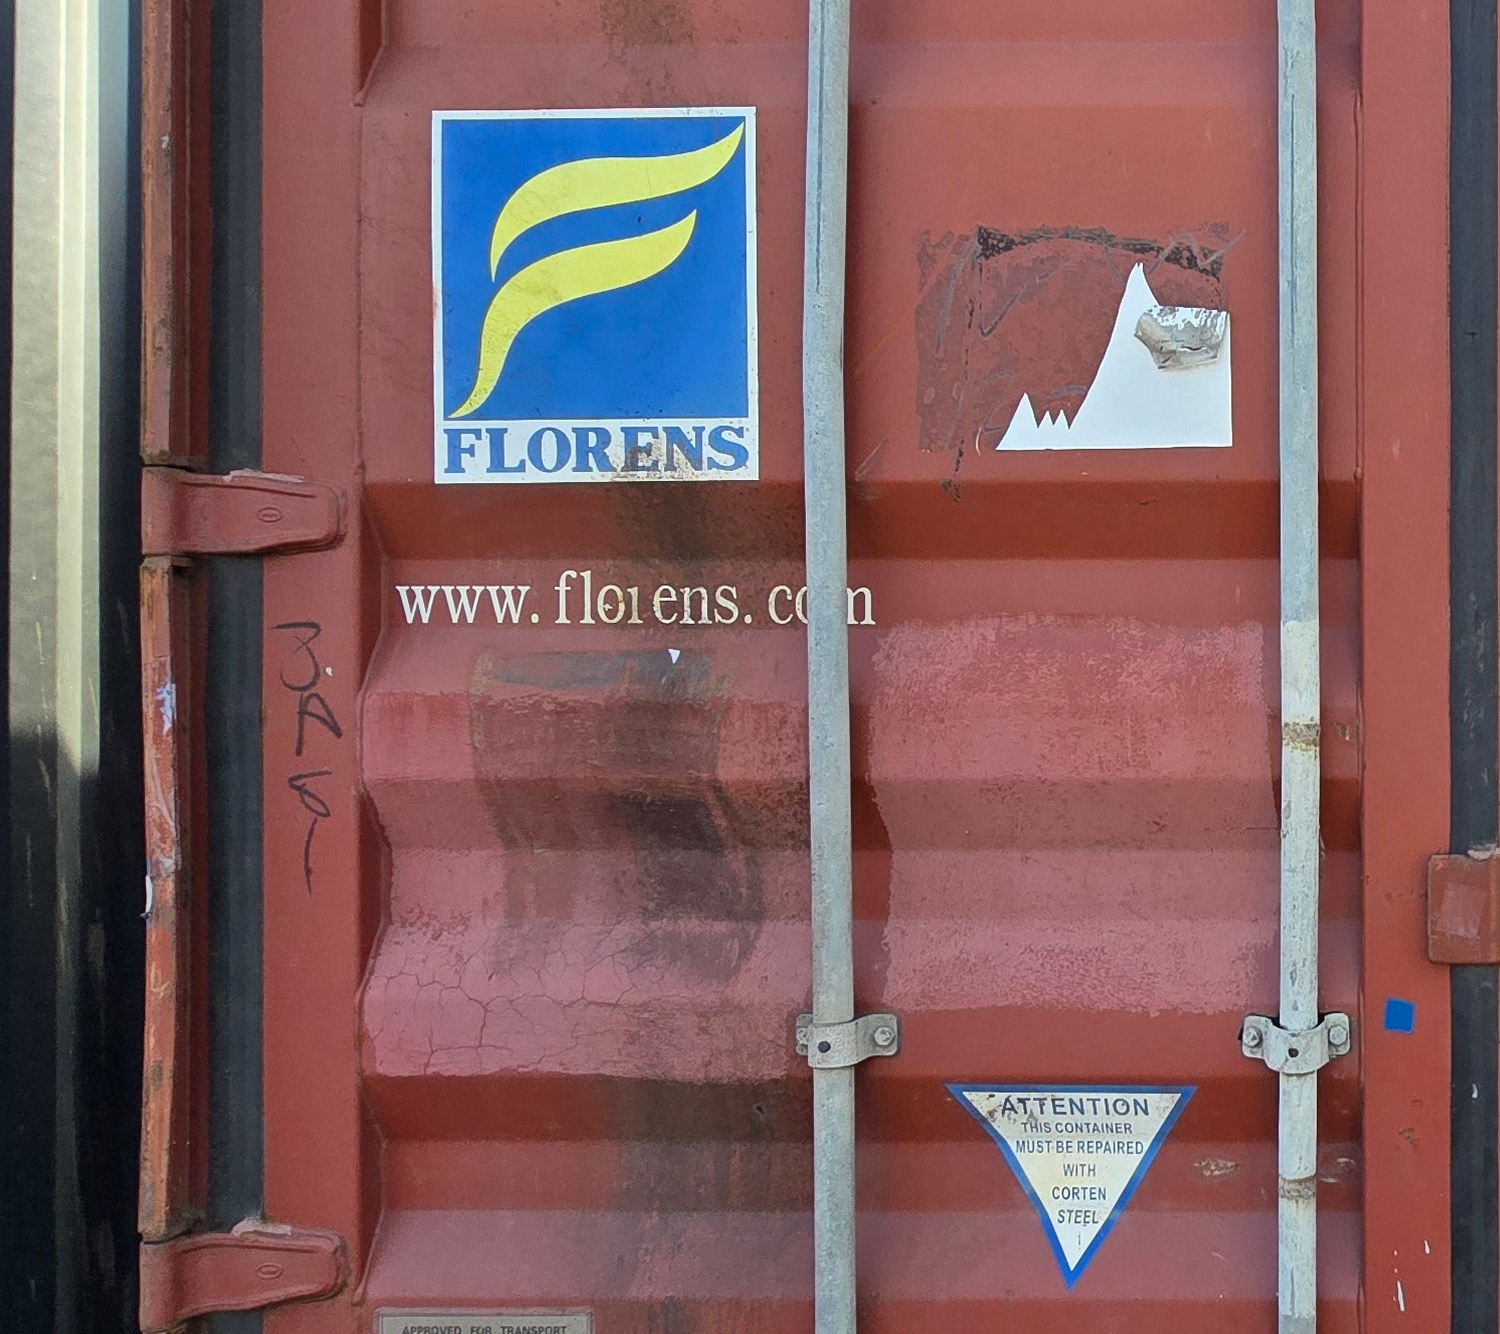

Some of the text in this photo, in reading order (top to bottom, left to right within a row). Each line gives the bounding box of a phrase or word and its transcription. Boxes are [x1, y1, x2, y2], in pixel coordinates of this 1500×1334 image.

[443, 424, 750, 475] FLORENS
[1001, 1096, 1150, 1117] ATTENTION
[1021, 1121, 1133, 1135] THIS CONTAINER
[1016, 1140, 1144, 1155] MUST BE REPAIRED
[1063, 1163, 1096, 1177] WITH
[1052, 1186, 1107, 1201] CORTEN
[1057, 1209, 1099, 1224] STEEL
